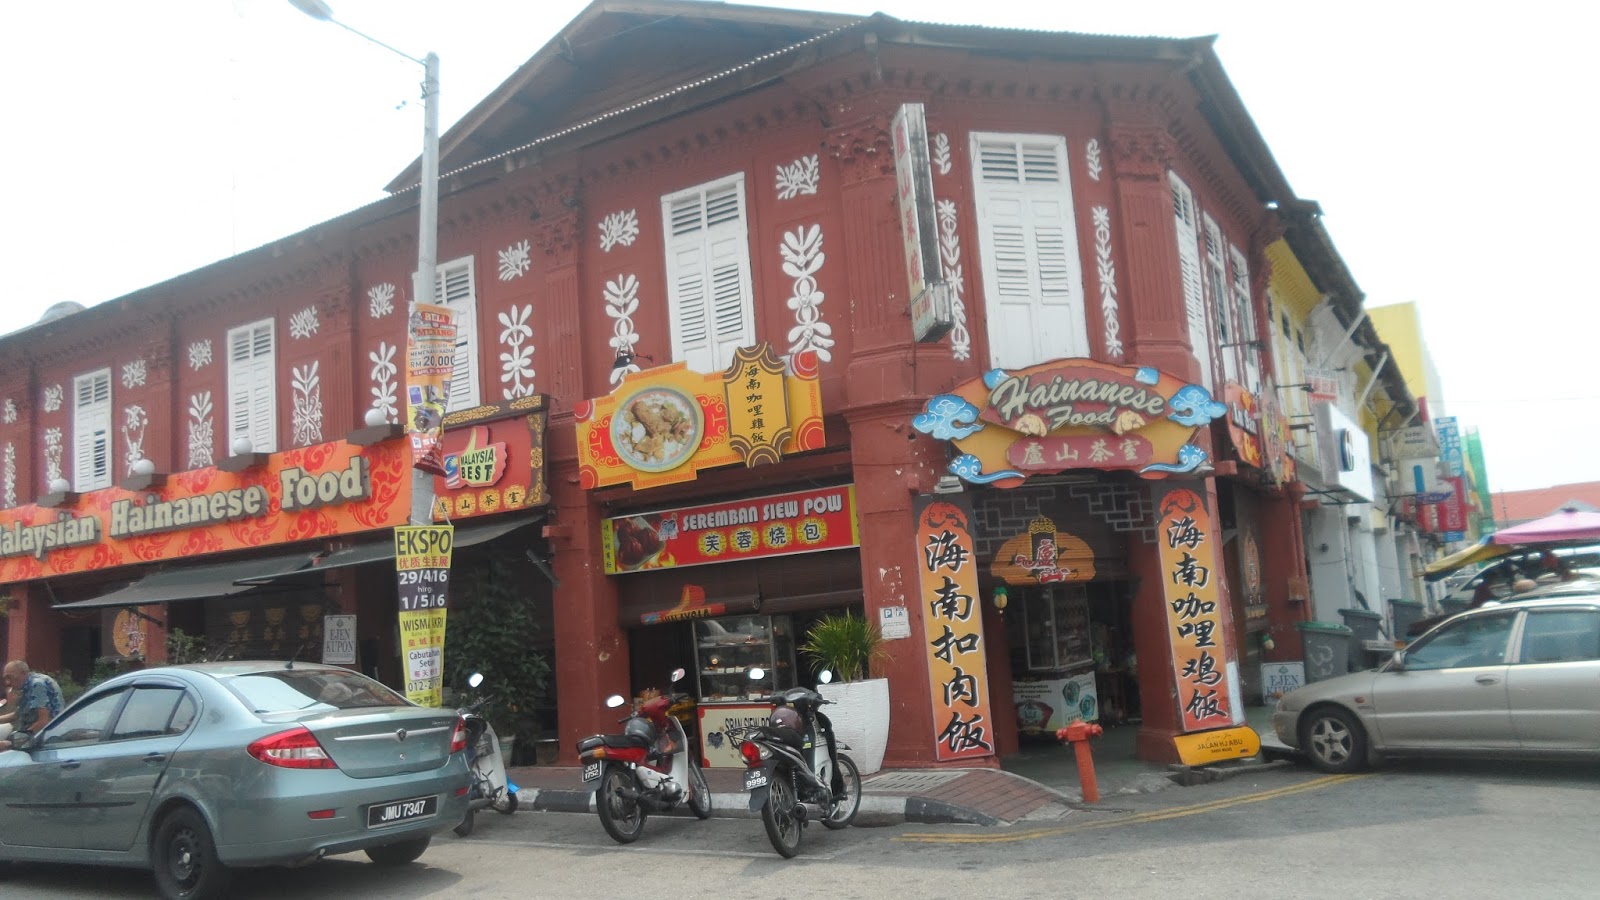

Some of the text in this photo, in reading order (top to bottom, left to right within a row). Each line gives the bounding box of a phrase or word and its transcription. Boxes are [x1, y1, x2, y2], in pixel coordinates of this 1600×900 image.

[990, 375, 1165, 420] Hainanese
[1046, 405, 1116, 431] Food
[461, 448, 494, 465] MALAYSIA
[461, 464, 493, 482] BEST
[0, 455, 363, 558] alaysian Hainanese Food
[682, 494, 843, 532] SEREMBAN SIEW POW
[396, 529, 452, 556] EKSPO
[706, 523, 821, 553] 芙蓉烧包
[330, 629, 351, 641] EJEN
[925, 530, 993, 752] 海南扣肉饭
[326, 640, 354, 653] KUPON
[1270, 675, 1298, 686] EJEN
[1197, 742, 1219, 750] JALAN
[585, 763, 598, 772] JCU
[585, 769, 599, 779] 1752
[750, 770, 761, 778] JS
[746, 777, 767, 788] 9999
[381, 800, 426, 821] JMU 7347
